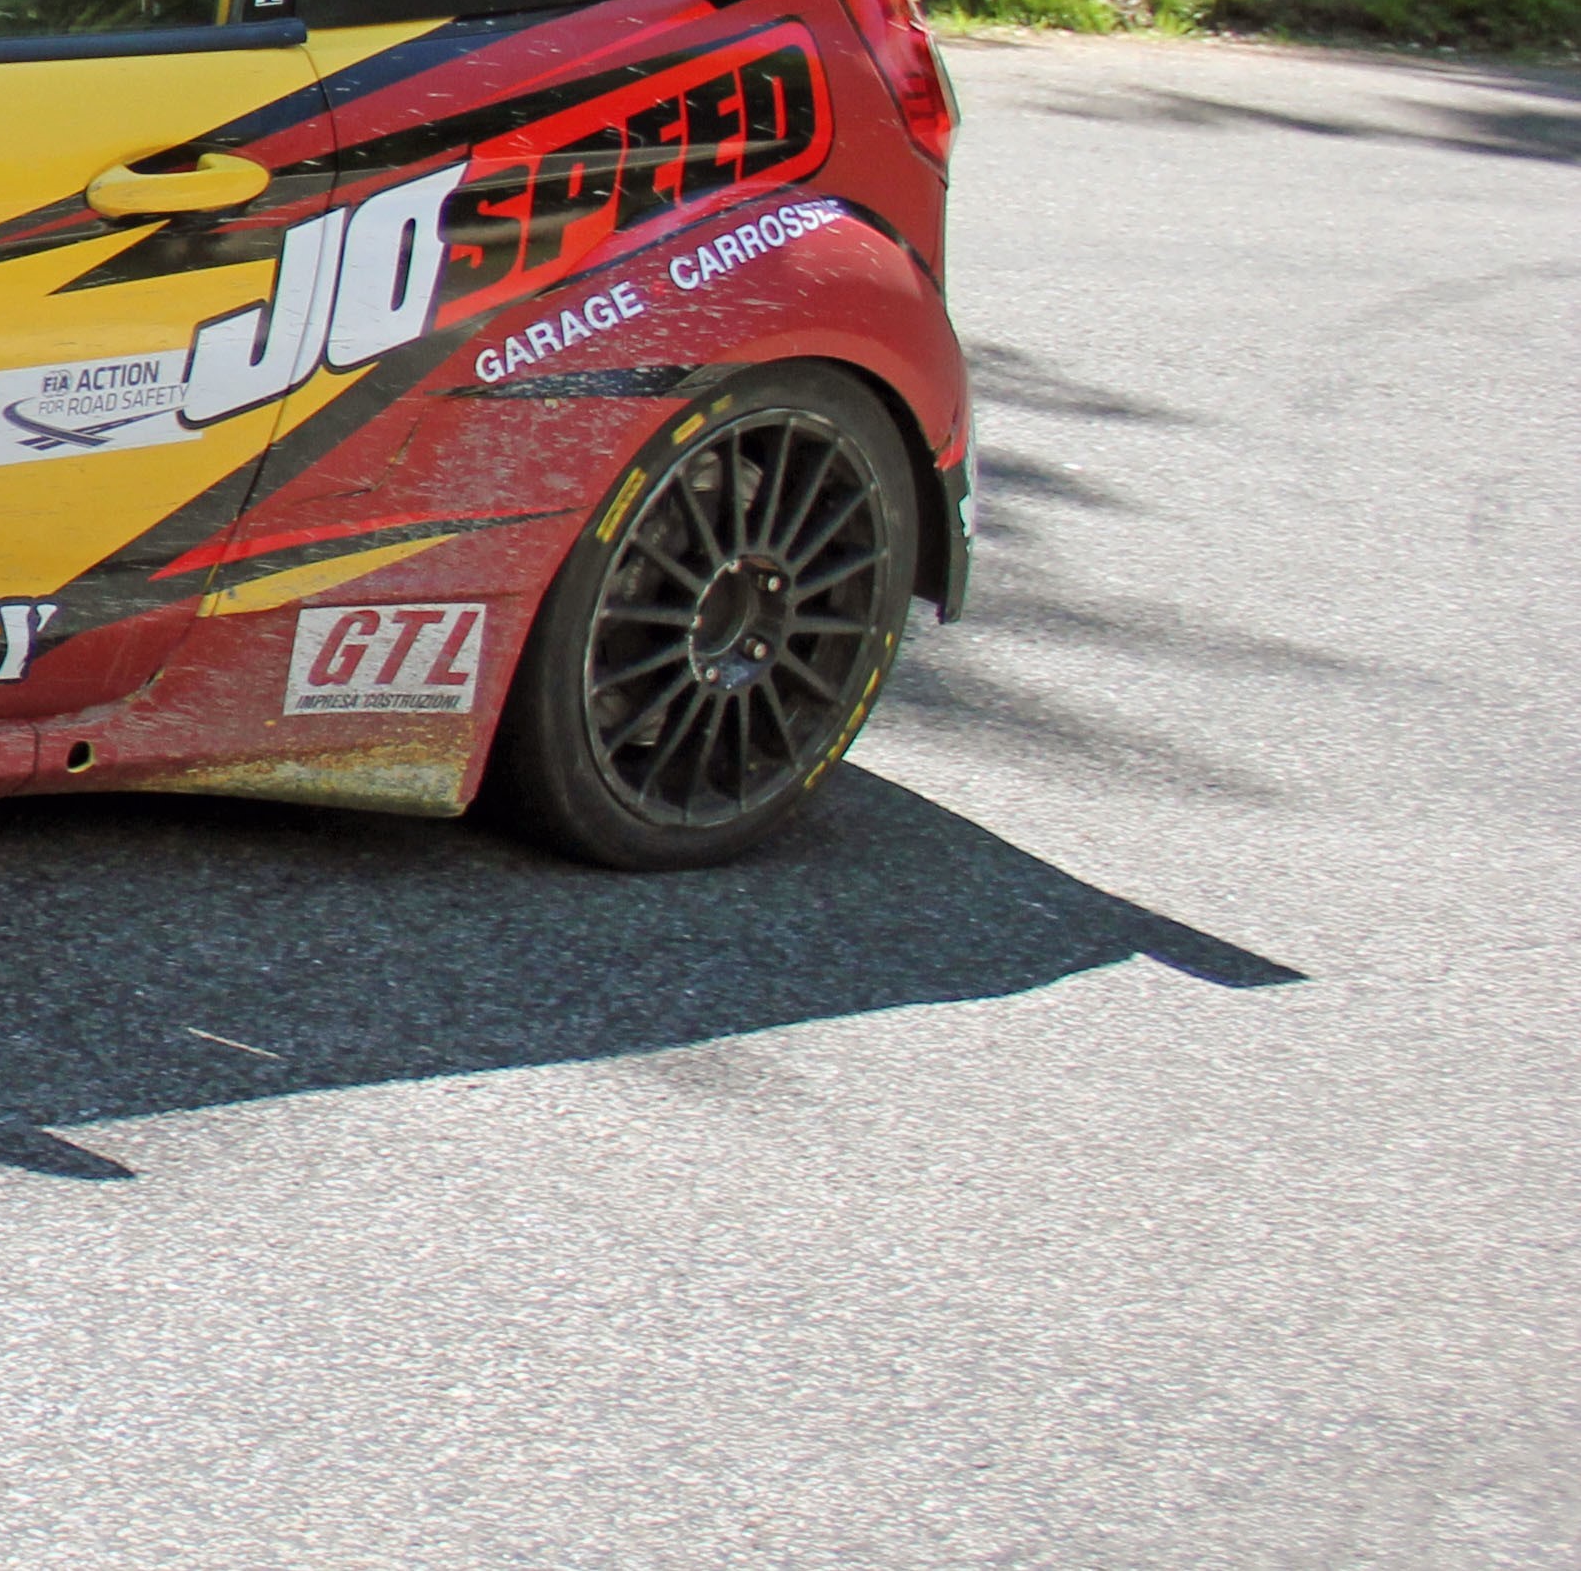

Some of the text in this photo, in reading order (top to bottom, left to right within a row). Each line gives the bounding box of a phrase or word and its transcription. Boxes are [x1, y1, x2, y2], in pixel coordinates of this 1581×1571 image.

[474, 280, 645, 384] GARAGE
[42, 360, 161, 394] FIA ACTION
[38, 384, 188, 417] FOR ROAD SAFETY
[307, 609, 480, 687] GTL
[295, 693, 462, 709] IMPRESA COSTRUZIONI
